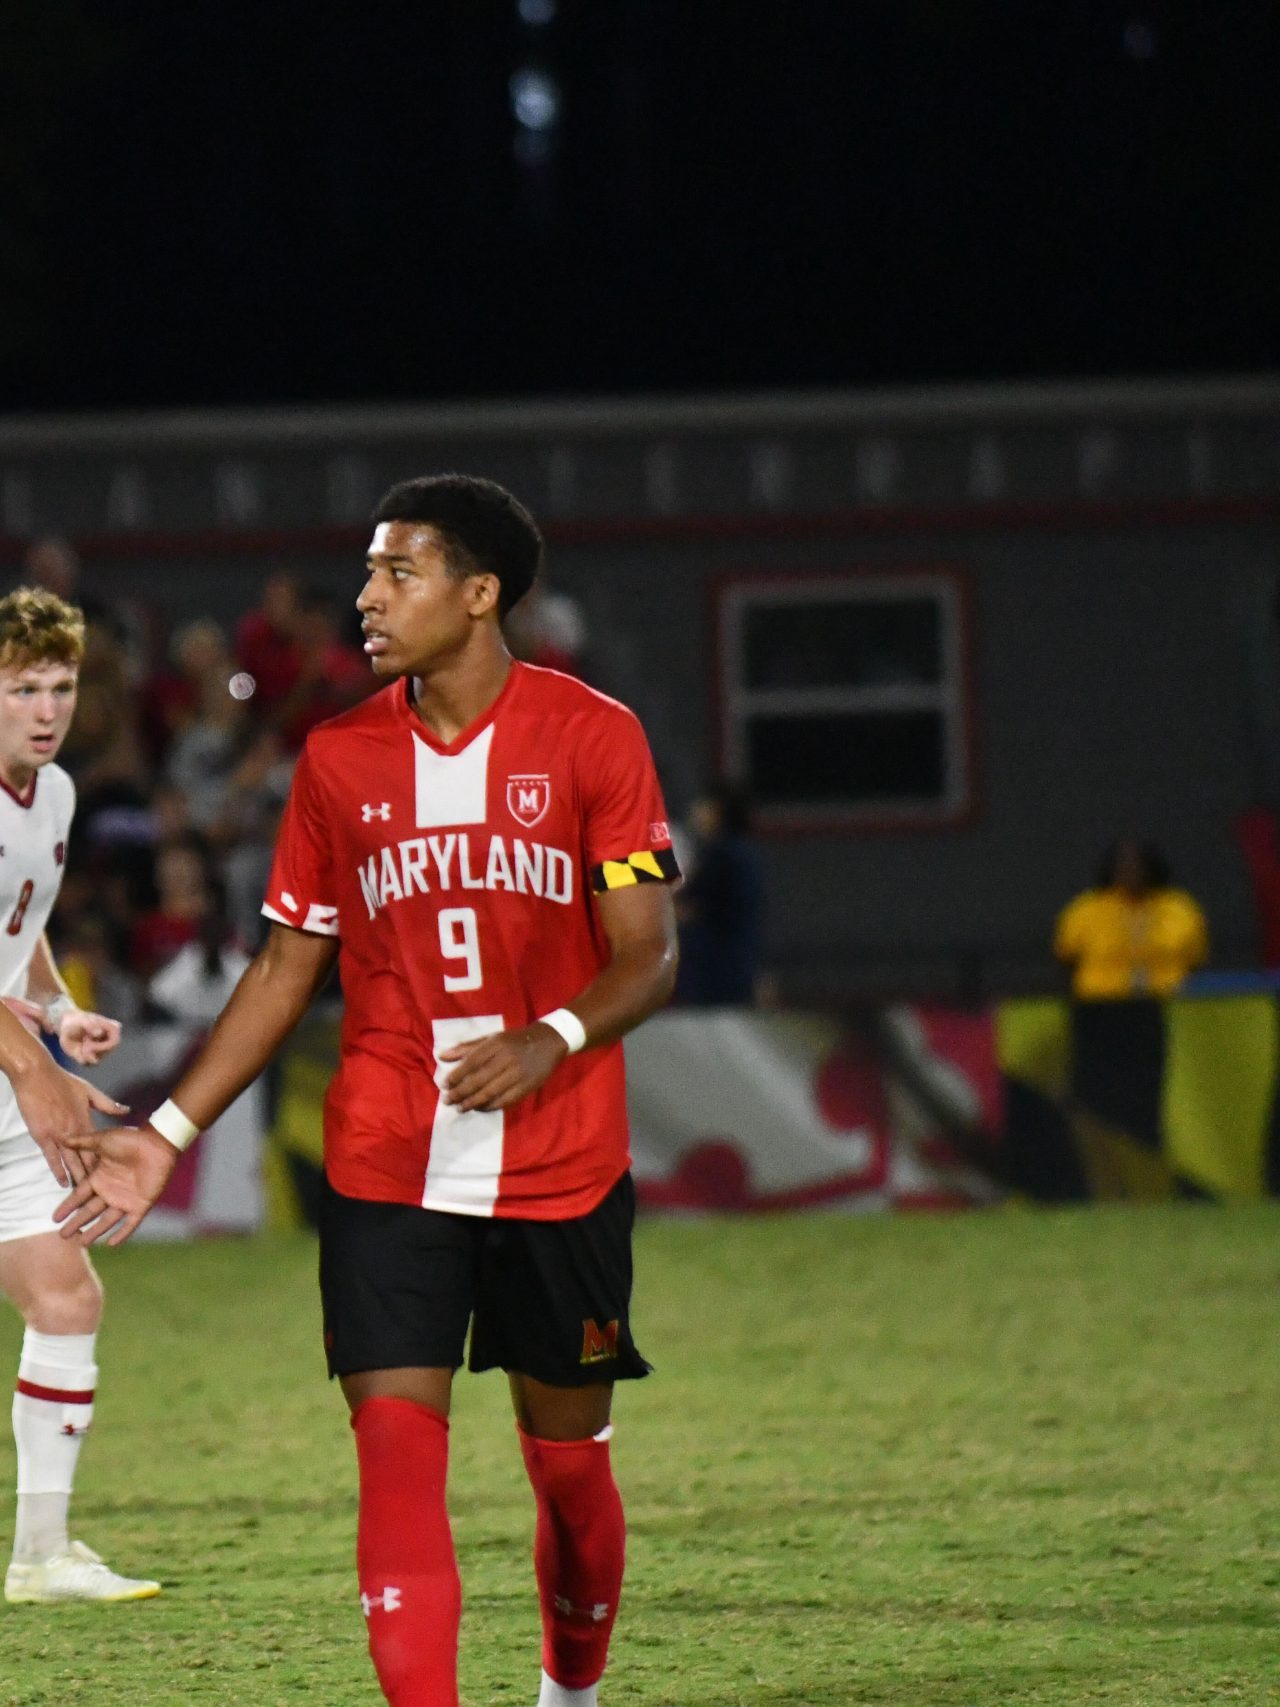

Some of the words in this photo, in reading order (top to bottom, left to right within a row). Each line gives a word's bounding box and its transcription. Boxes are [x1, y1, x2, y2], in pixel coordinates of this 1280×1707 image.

[518, 788, 538, 812] M
[357, 832, 573, 921] MARYLAND
[6, 879, 34, 936] 8
[437, 907, 483, 993] 9
[580, 1317, 619, 1364] M
